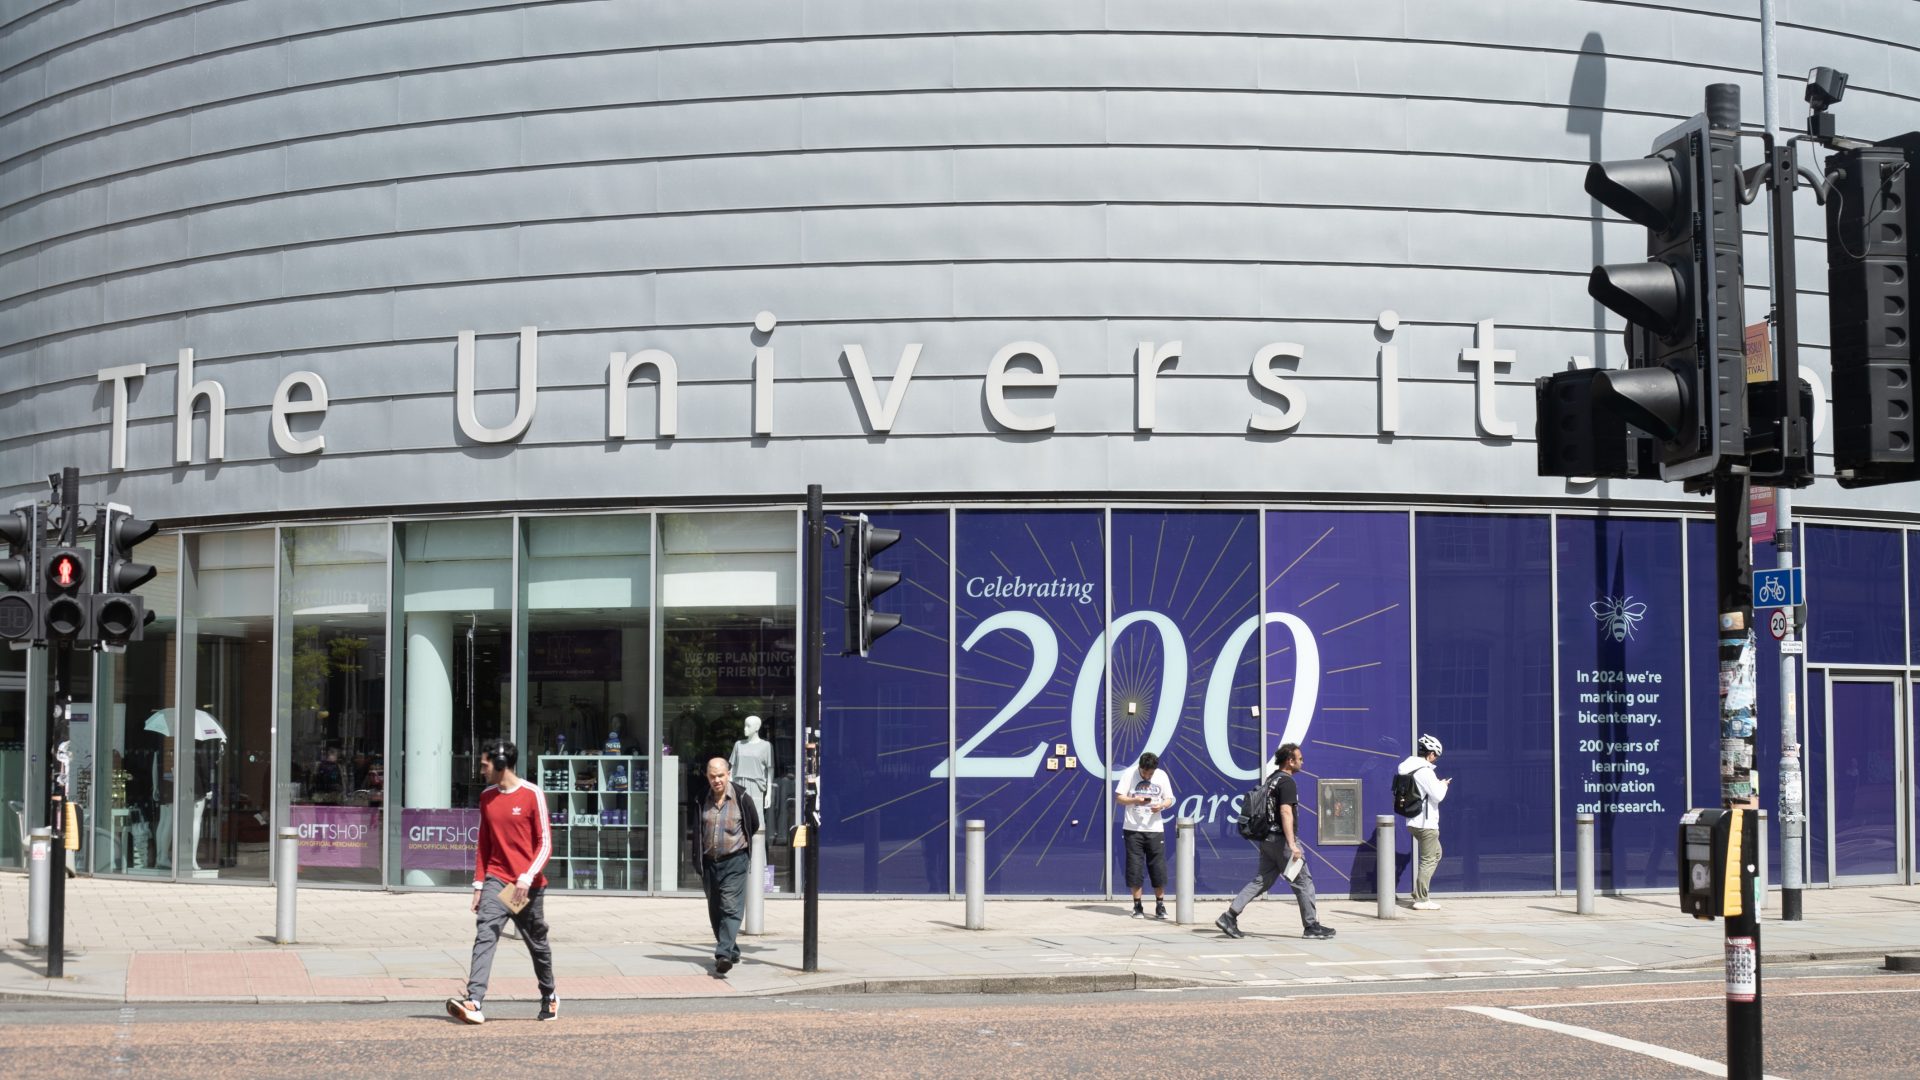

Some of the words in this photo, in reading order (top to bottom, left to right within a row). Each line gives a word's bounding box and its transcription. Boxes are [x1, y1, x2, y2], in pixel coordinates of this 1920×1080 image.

[1747, 365, 1765, 375] TIVAL
[97, 347, 329, 469] The
[457, 310, 1627, 484] Universit
[966, 576, 1095, 604] Celebrating
[1773, 618, 1785, 630] 20
[684, 652, 723, 664] WE'RE
[725, 651, 790, 663] PLANTING
[684, 666, 782, 678] ECO-FRIENDLY
[1577, 670, 1589, 683] In
[1592, 670, 1624, 683] 2024
[1626, 670, 1662, 683] we're
[930, 610, 1320, 781] 200
[1580, 691, 1634, 706] marking
[1637, 693, 1659, 703] our
[1578, 711, 1661, 726] bicentenary.
[1580, 740, 1603, 752] 200
[1606, 742, 1643, 755] years
[1645, 739, 1660, 752] of
[1592, 760, 1650, 775] learning,
[1584, 780, 1655, 792] innovation
[1160, 794, 1245, 824] ears
[1576, 801, 1601, 813] and
[1604, 800, 1665, 813] research.
[298, 823, 368, 840] GIFTSHOP
[409, 826, 480, 842] GIFTSHO
